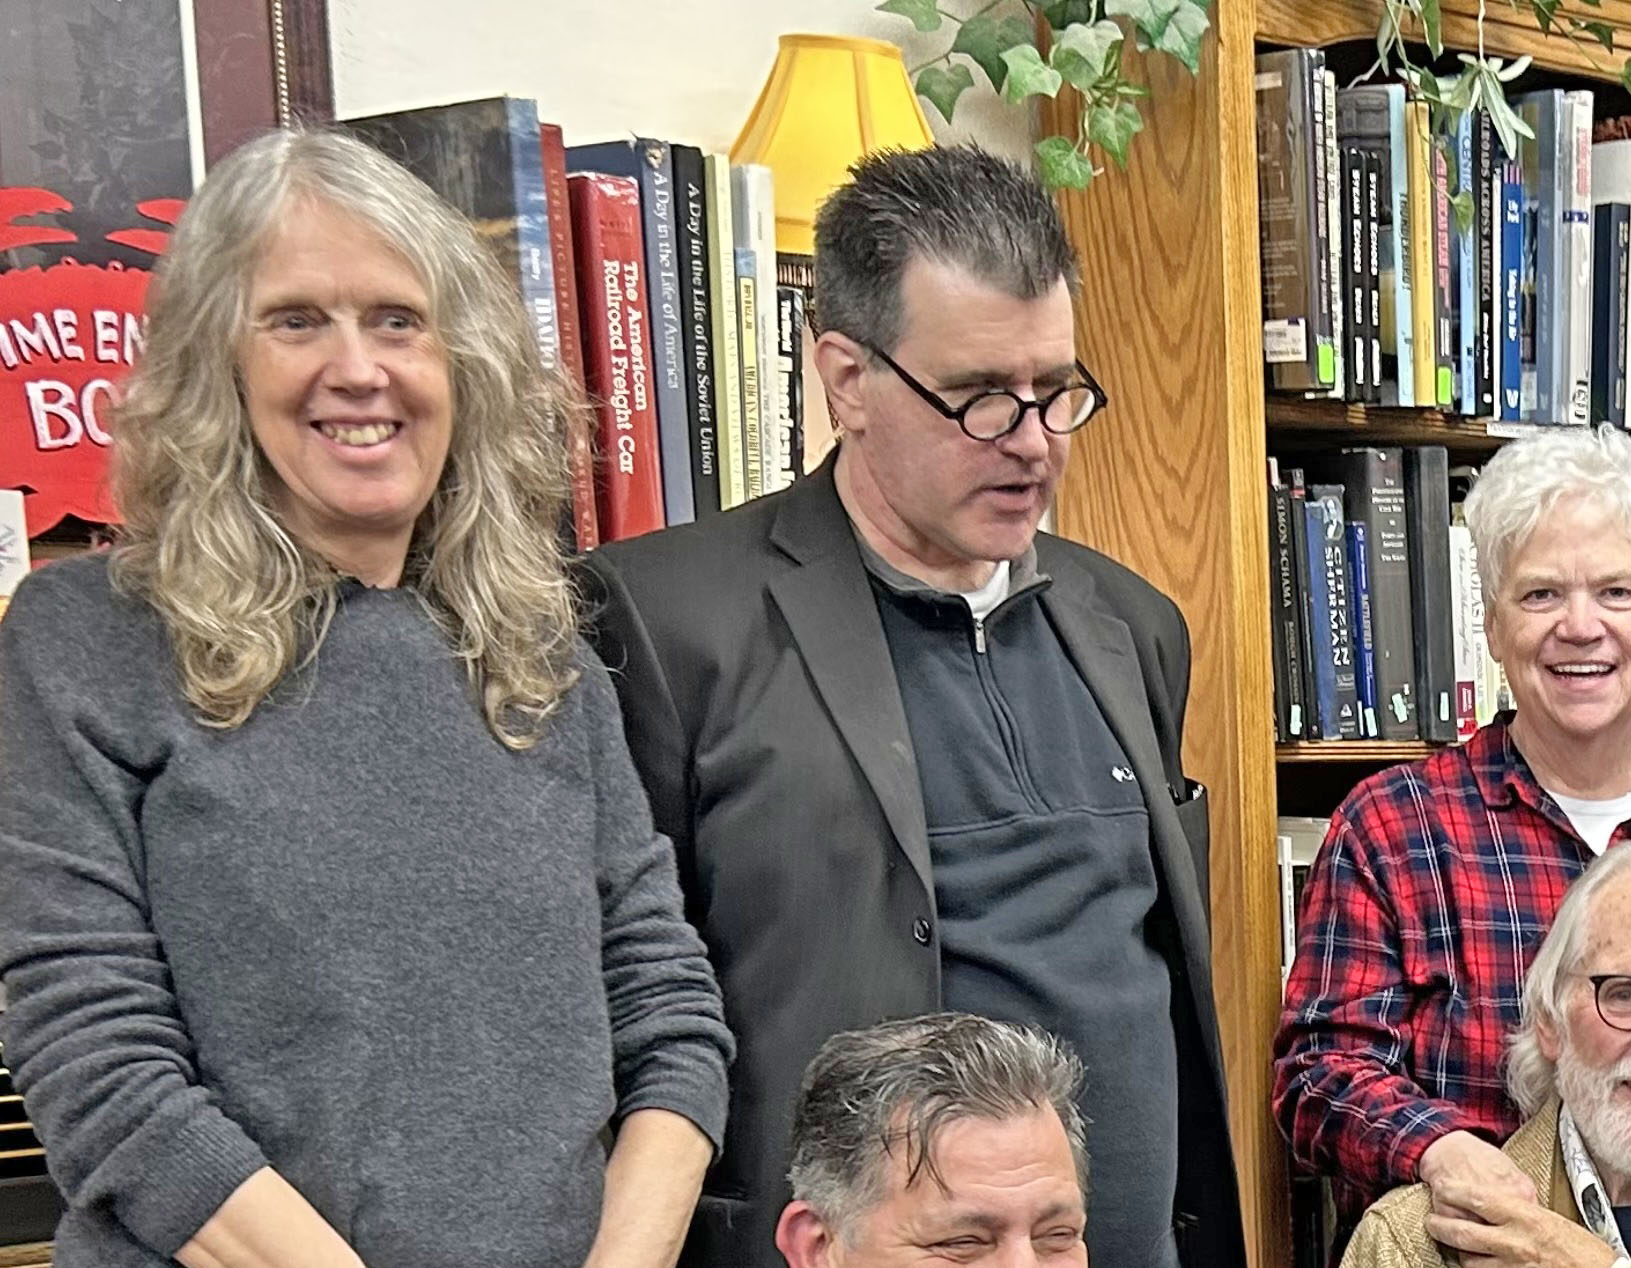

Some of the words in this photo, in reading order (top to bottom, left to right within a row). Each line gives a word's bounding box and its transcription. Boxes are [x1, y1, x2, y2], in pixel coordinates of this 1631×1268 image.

[1480, 110, 1491, 177] AILROADS
[654, 172, 668, 185] A
[687, 183, 700, 198] A
[653, 189, 671, 220] Day
[686, 201, 702, 236] Day
[1481, 180, 1491, 235] ACROSS
[657, 223, 673, 240] in
[691, 238, 703, 255] in
[659, 241, 674, 268] the
[692, 259, 705, 286] the
[1481, 239, 1491, 302] AMERICA
[623, 262, 640, 300] The
[660, 270, 676, 299] Life
[604, 259, 630, 350] Railroad
[662, 302, 678, 321] of
[693, 288, 707, 323] Life
[0, 308, 85, 370] IME
[94, 309, 152, 367] EN
[694, 324, 708, 343] of
[627, 306, 648, 411] American
[664, 323, 680, 389] America
[696, 344, 710, 370] the
[609, 354, 633, 429] Freight
[697, 373, 712, 423] Soviet
[25, 378, 120, 451] BO
[617, 434, 635, 475] Car
[700, 426, 715, 476] Union
[1276, 496, 1289, 544] SIMON
[1279, 547, 1292, 608] SCHAMA
[1324, 545, 1342, 667] SHERMAN
[1332, 545, 1352, 667] CITIZEN
